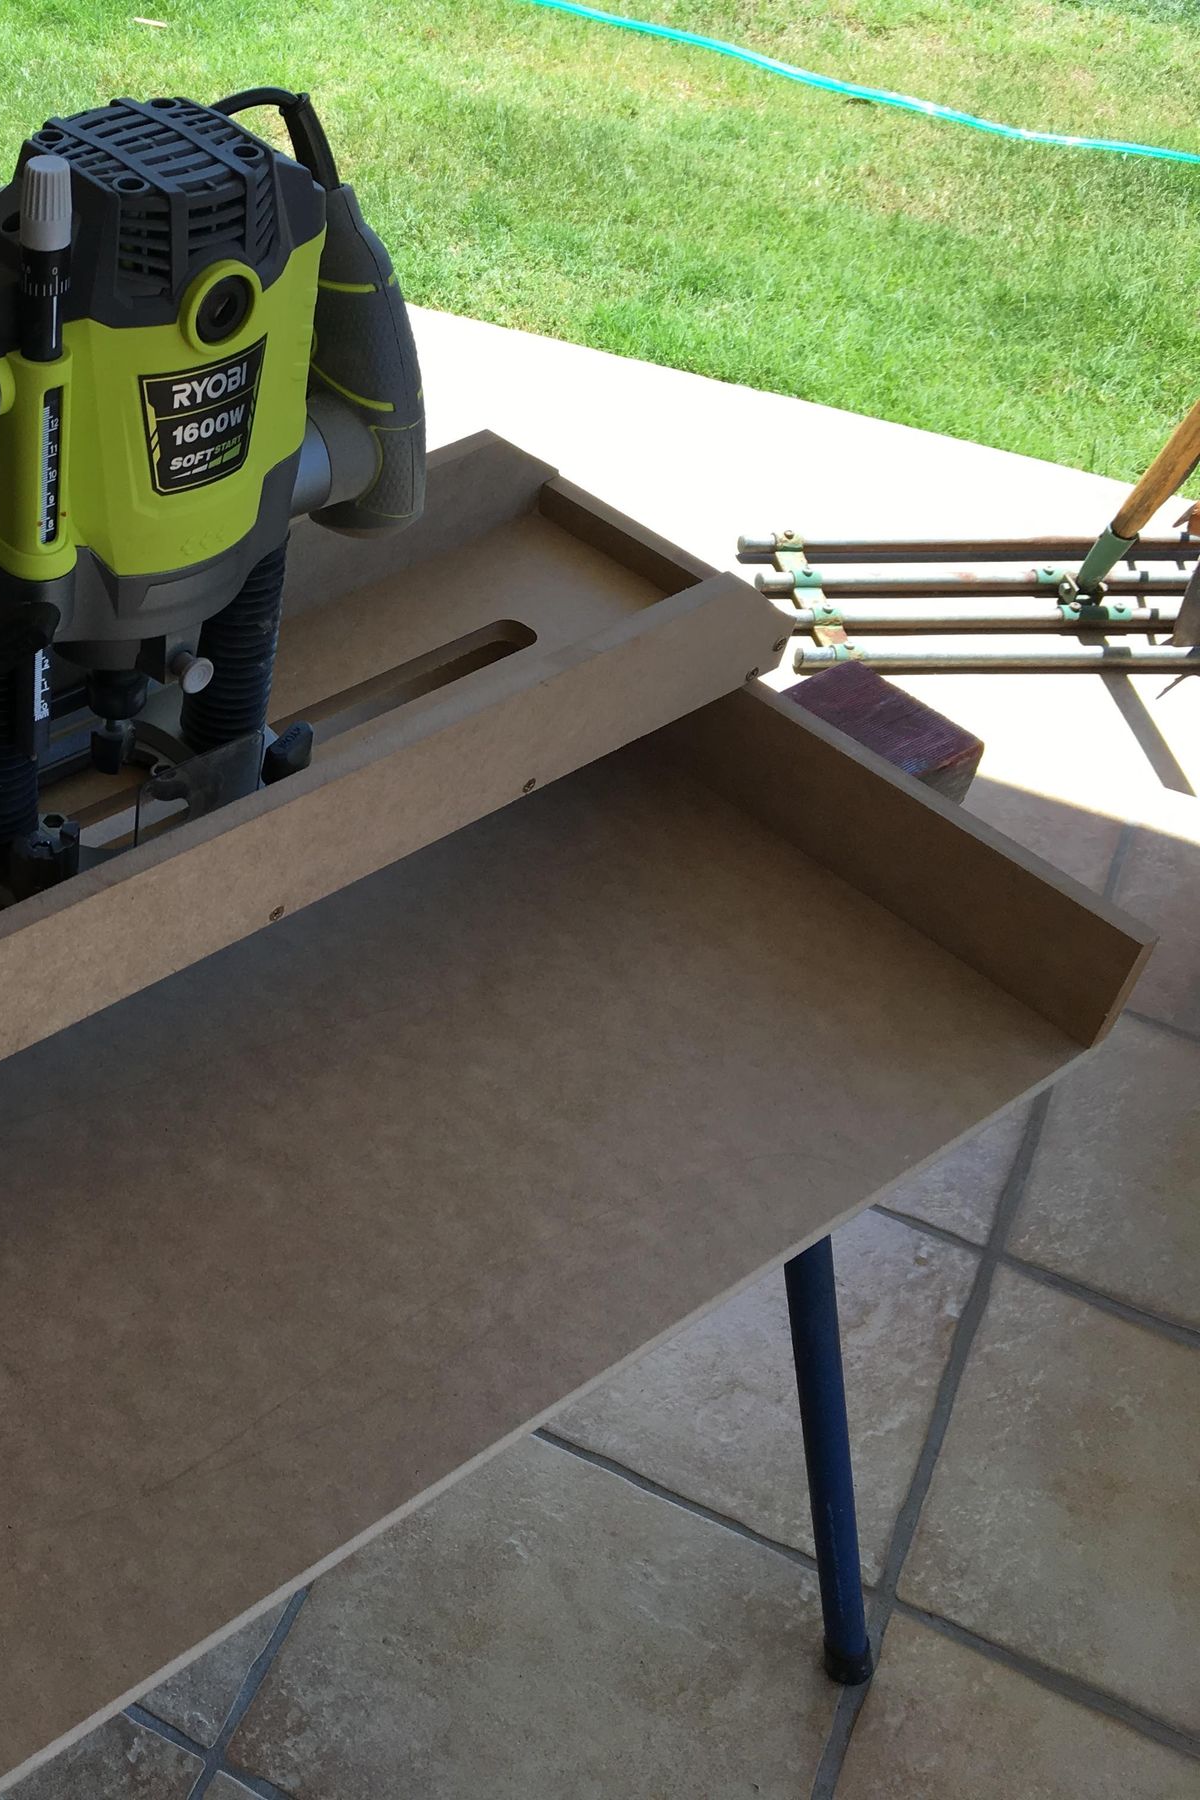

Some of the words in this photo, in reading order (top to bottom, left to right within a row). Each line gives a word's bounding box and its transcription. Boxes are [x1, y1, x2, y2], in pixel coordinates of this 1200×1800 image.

[171, 361, 248, 409] RYOBI
[50, 418, 59, 428] 12
[172, 404, 246, 446] 1600W
[50, 444, 58, 454] 11
[48, 469, 57, 480] 10
[48, 495, 55, 504] 9
[47, 519, 54, 528] 8
